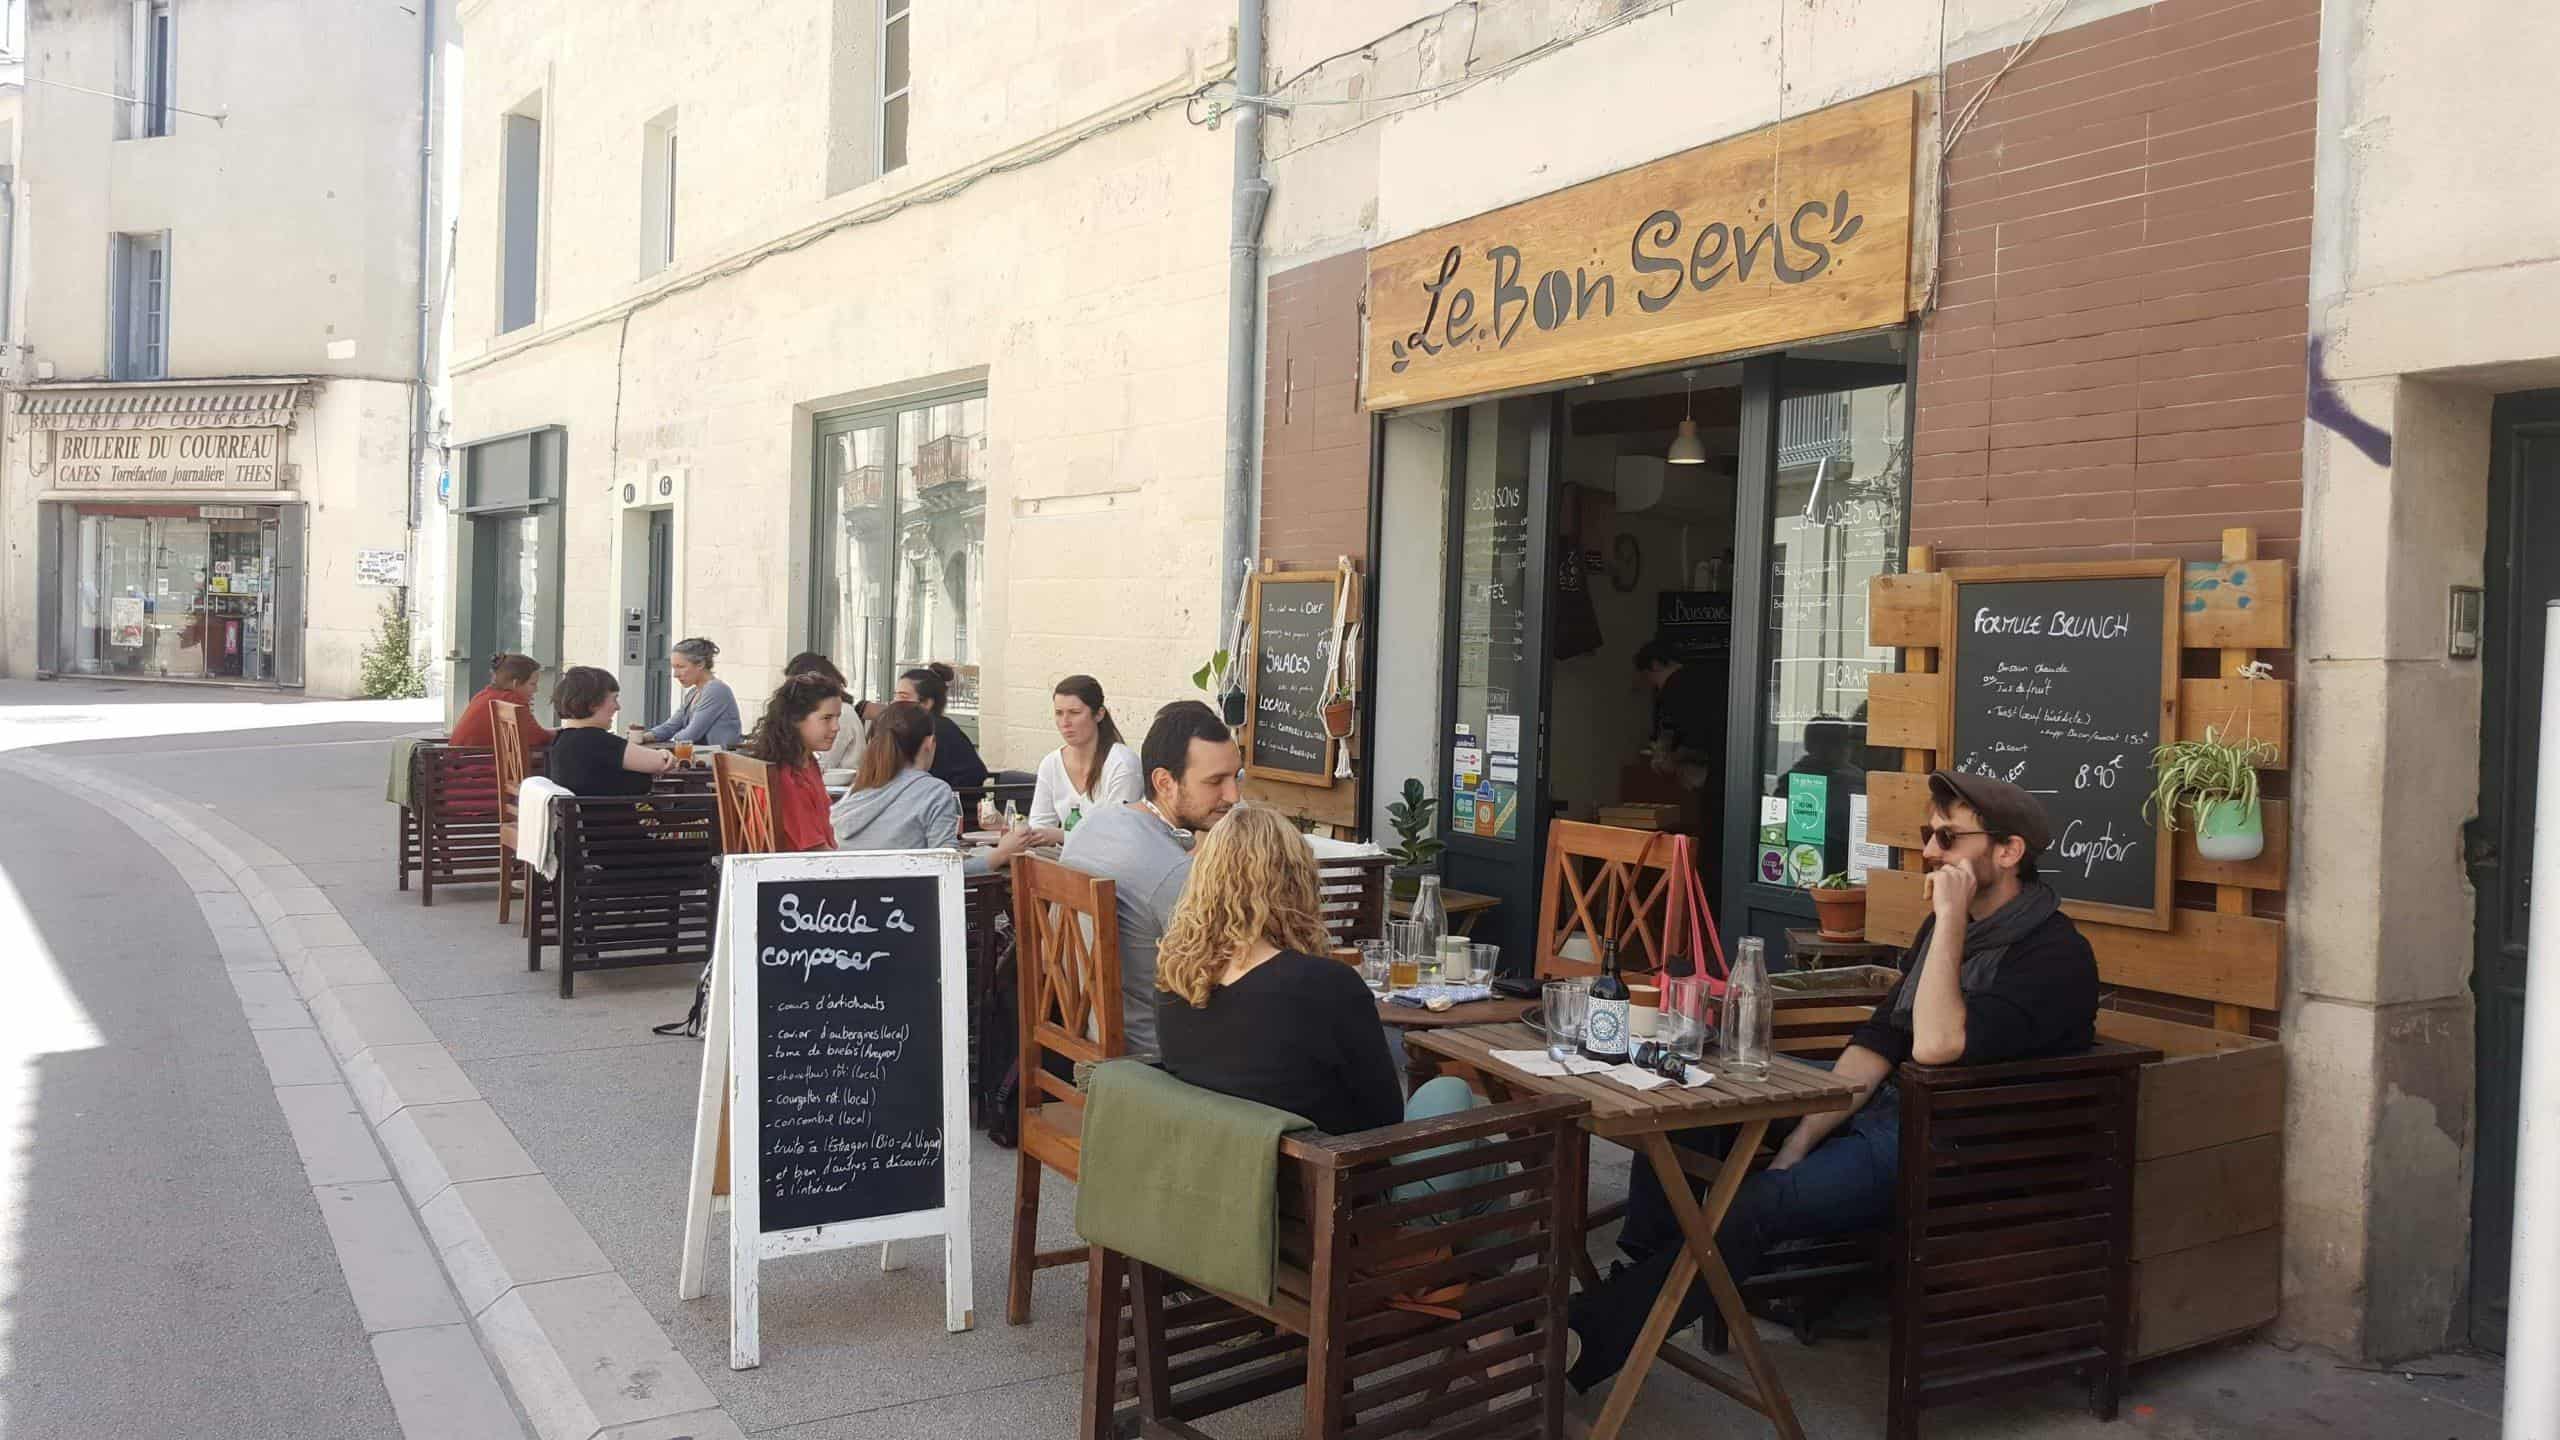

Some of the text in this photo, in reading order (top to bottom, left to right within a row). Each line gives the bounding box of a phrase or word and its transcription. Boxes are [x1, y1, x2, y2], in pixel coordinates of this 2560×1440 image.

[1487, 245, 1613, 349] Bon
[1631, 200, 1831, 313] Sens
[61, 434, 274, 460] BRULERIE DU COURREAU
[59, 464, 273, 485] CAFES Torréfaction journalière THES
[1974, 607, 2129, 639] FORMULE BRUNCH
[1266, 646, 1310, 674] SALADES
[2060, 819, 2136, 879] Comptoir
[779, 893, 879, 933] Salade
[762, 946, 890, 983] composer
